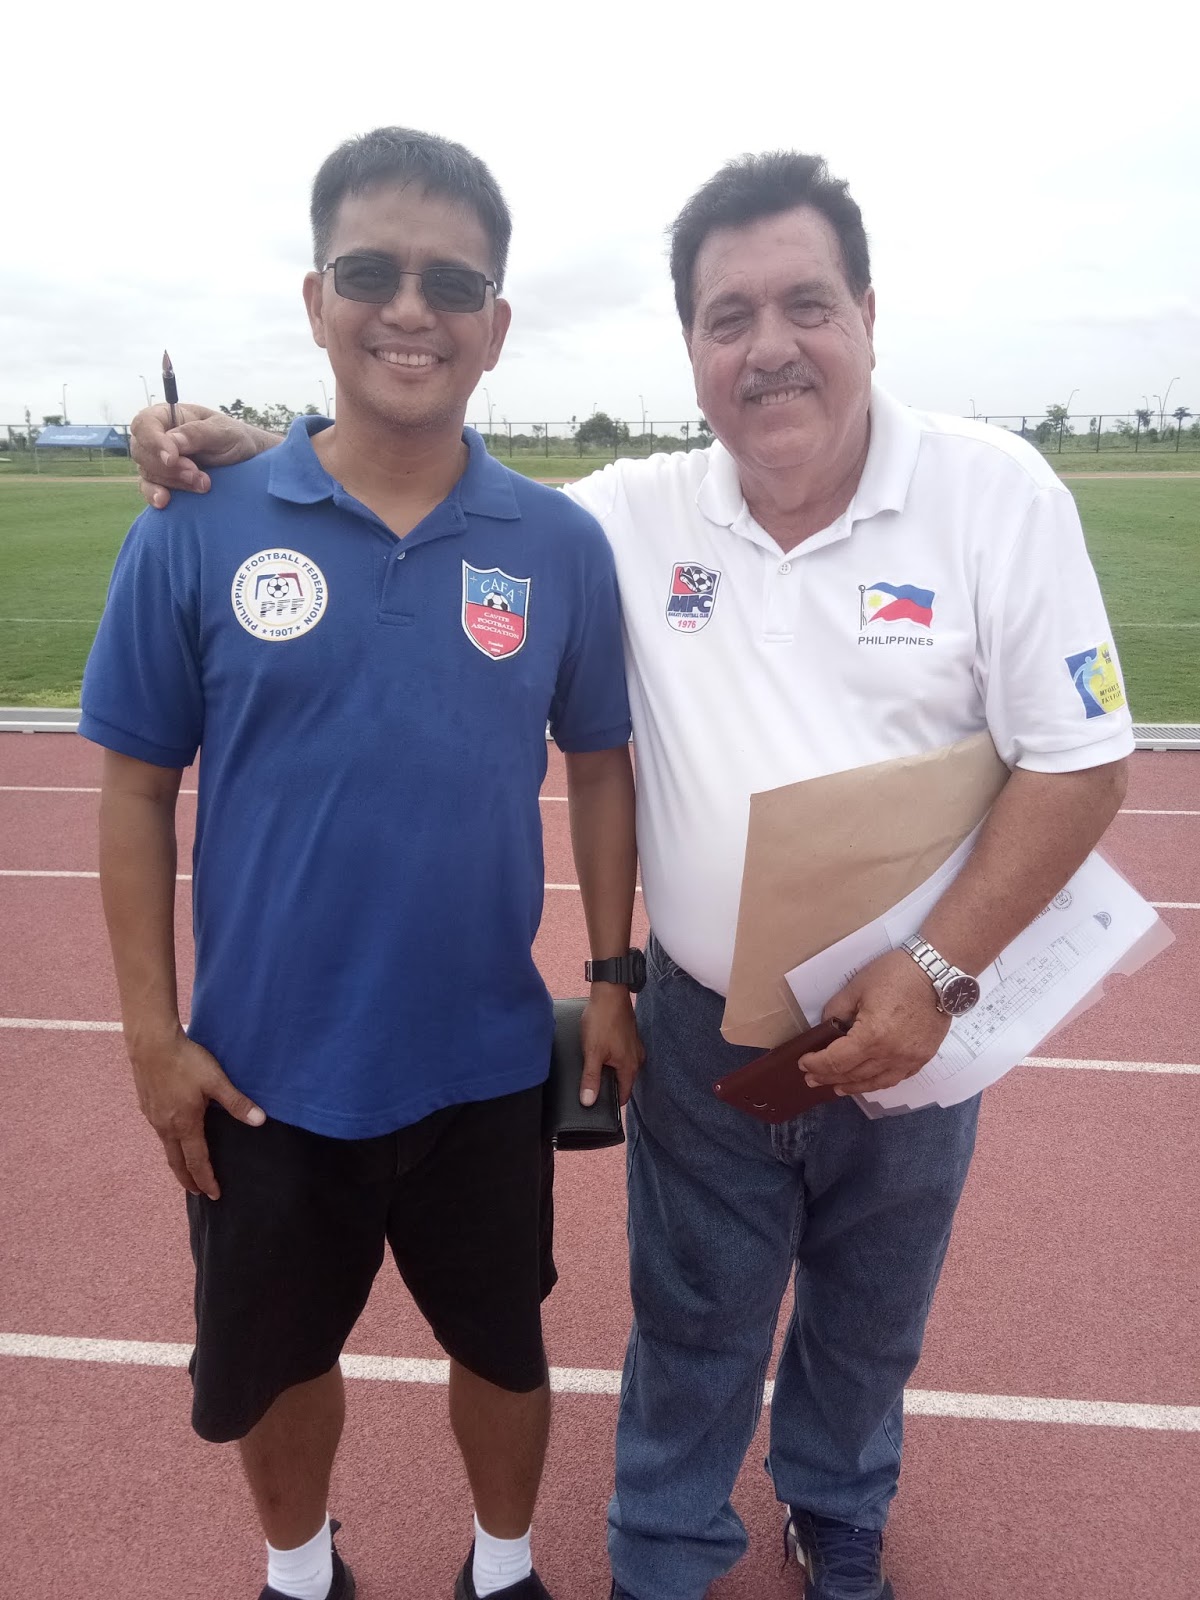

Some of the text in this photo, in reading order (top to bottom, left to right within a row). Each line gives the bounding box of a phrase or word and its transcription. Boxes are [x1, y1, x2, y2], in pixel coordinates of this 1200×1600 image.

[235, 553, 323, 631] PHILIPPINE FOOTBALL FEDERATION
[480, 578, 515, 603] CAFA
[667, 595, 713, 613] MFC
[477, 617, 515, 632] FOOTBALL
[484, 612, 510, 623] CAVITE
[678, 620, 697, 629] 1976
[269, 627, 293, 637] 1907
[471, 623, 519, 639] ASSOCIATION
[858, 636, 934, 646] PHILIPPINES
